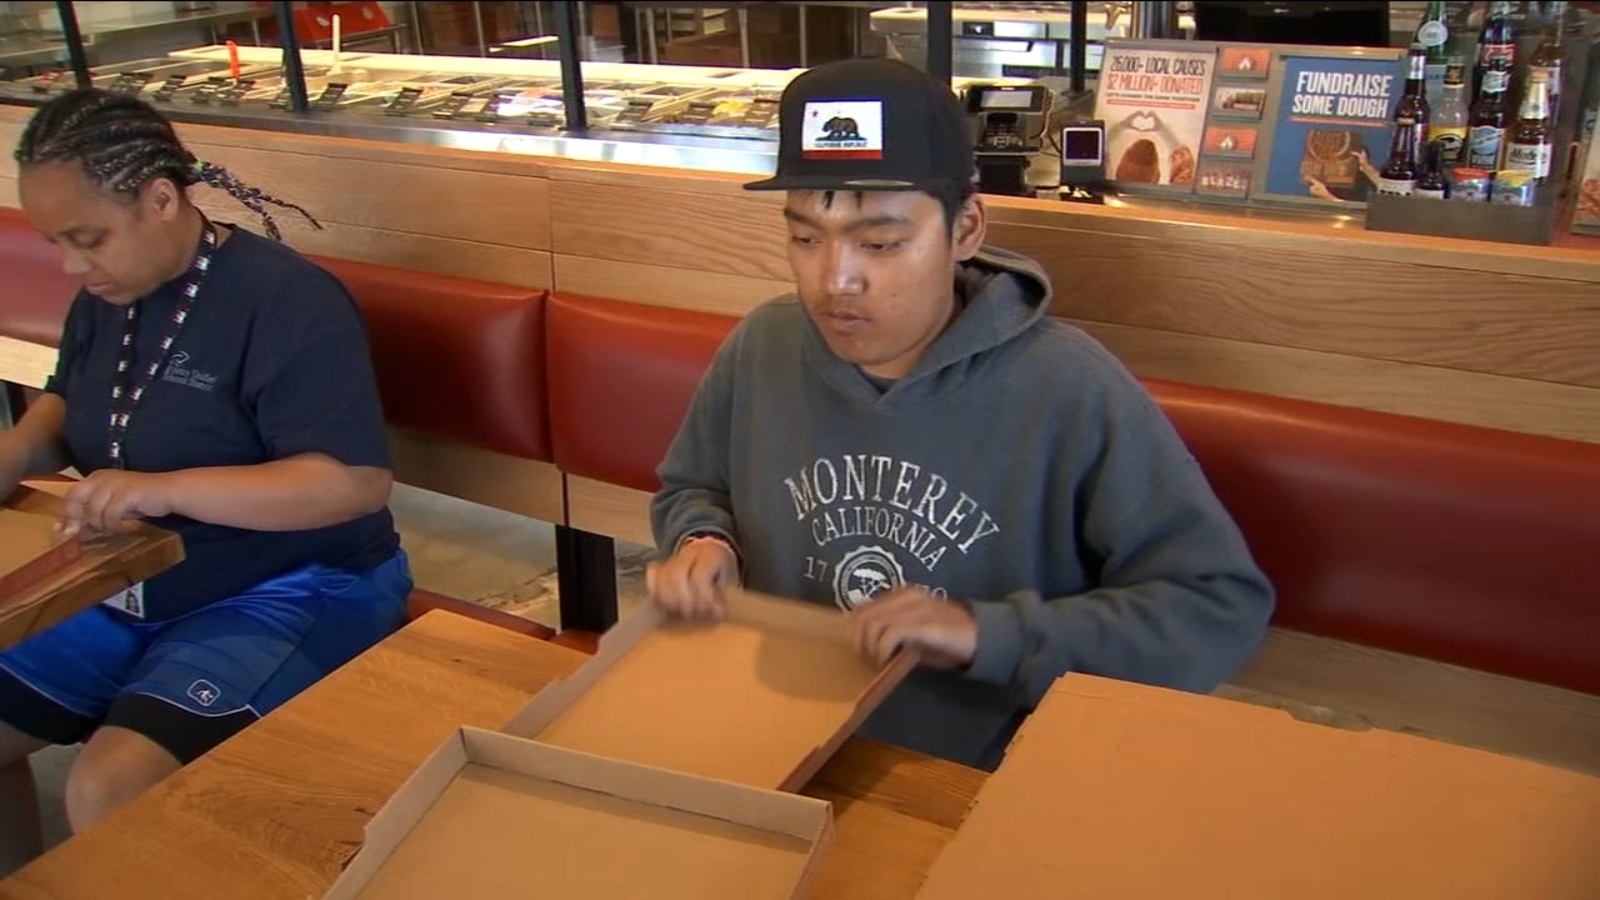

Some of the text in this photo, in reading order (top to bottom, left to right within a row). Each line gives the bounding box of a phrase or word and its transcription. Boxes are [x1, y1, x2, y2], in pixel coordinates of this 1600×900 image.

[1145, 57, 1171, 75] LOCAL
[1173, 58, 1206, 76] CAUSES
[1159, 76, 1205, 96] DONATED
[1296, 71, 1394, 98] FUNDRAISE
[1292, 94, 1389, 118] SOME DOUGH
[784, 454, 1000, 554] MONTEREY
[812, 506, 946, 572] CALIFORNIA
[803, 556, 828, 582] 17
